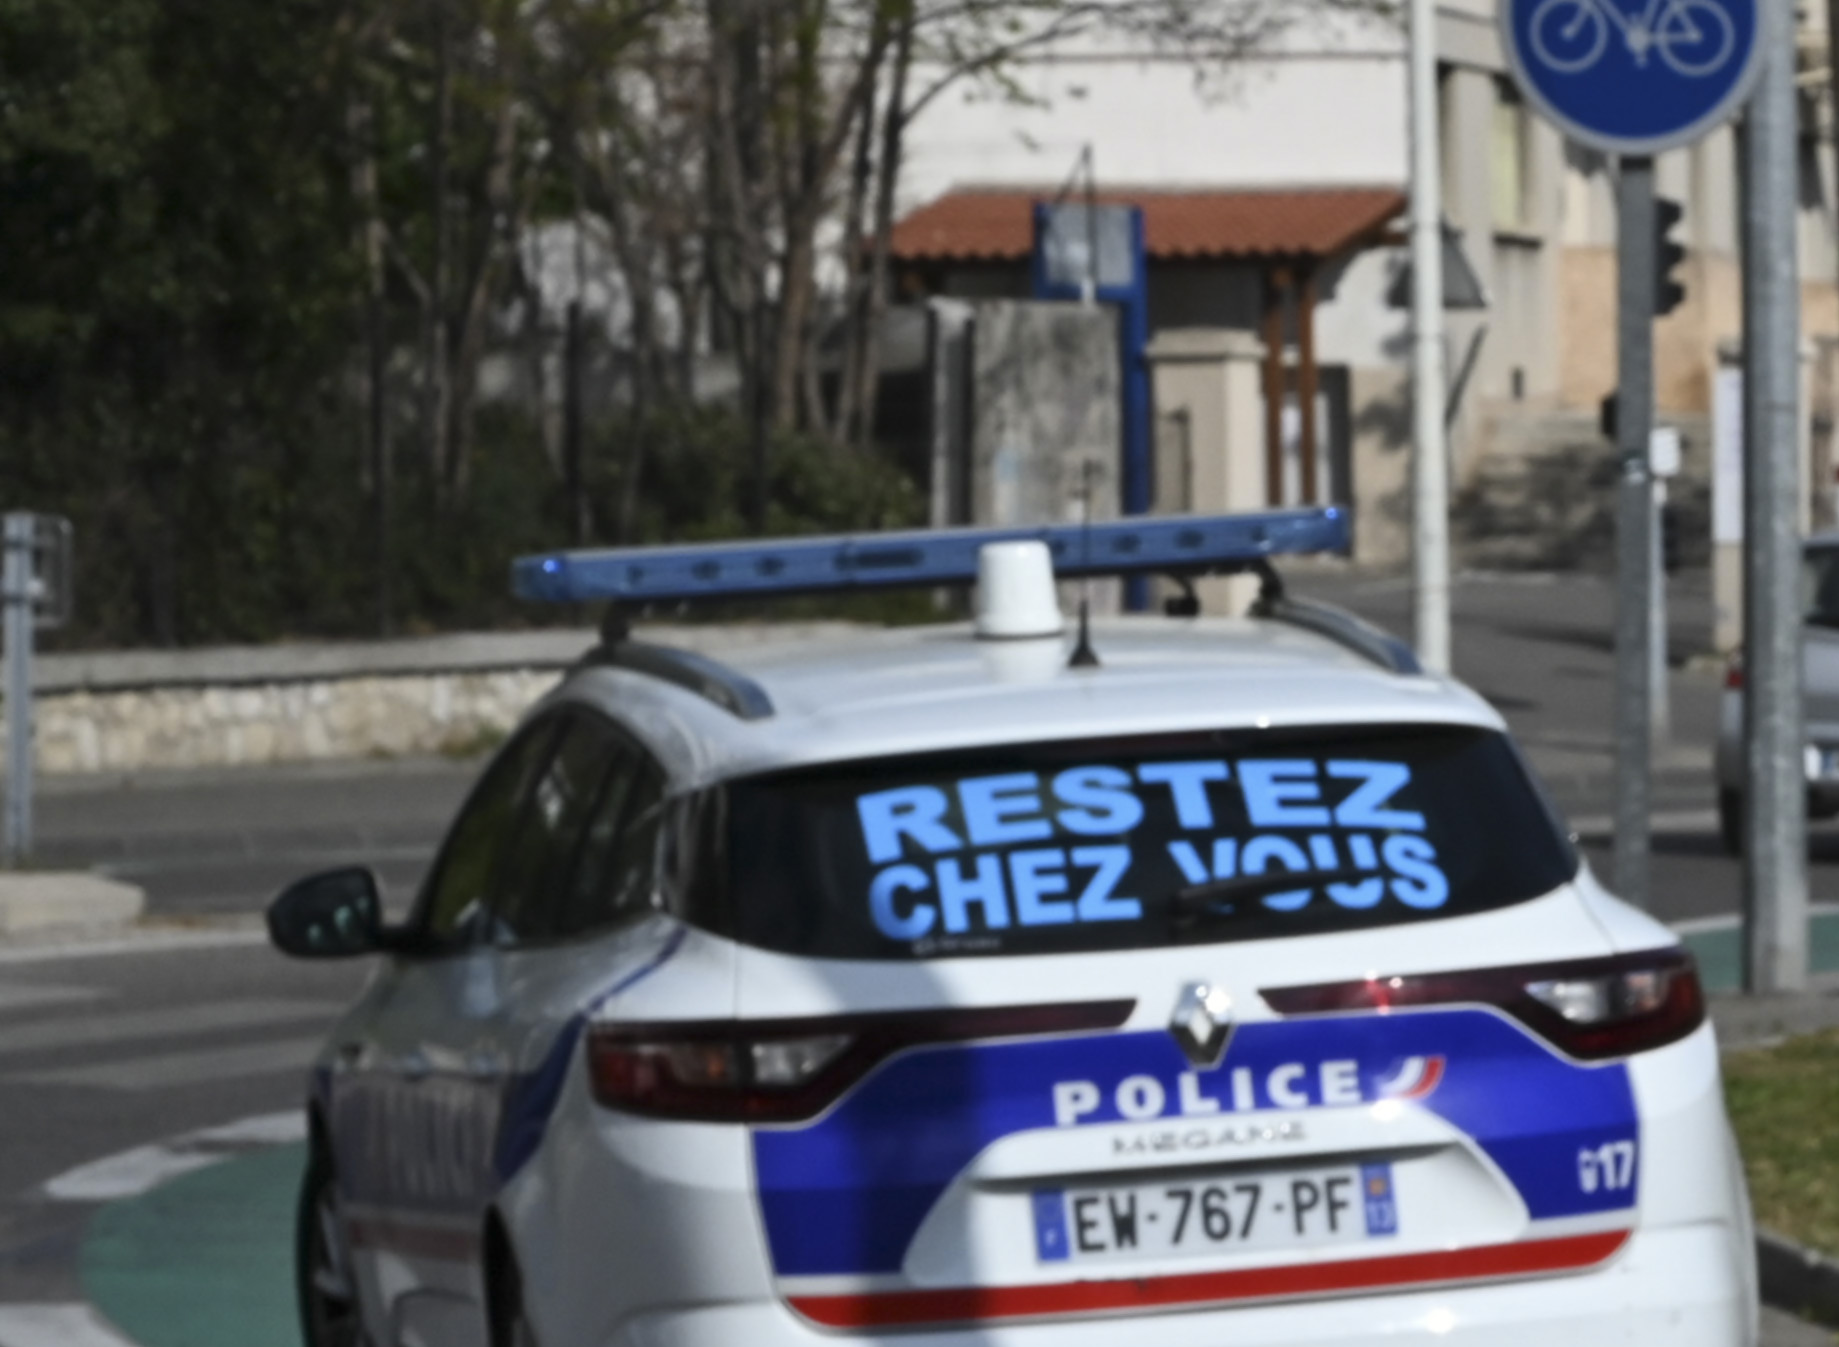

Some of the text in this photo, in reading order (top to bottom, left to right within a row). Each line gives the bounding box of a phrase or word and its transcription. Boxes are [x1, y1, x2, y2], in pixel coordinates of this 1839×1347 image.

[857, 759, 1427, 865] RESTEZ
[868, 833, 1449, 941] CHEZ VOUS
[1052, 1059, 1363, 1128] POLICE
